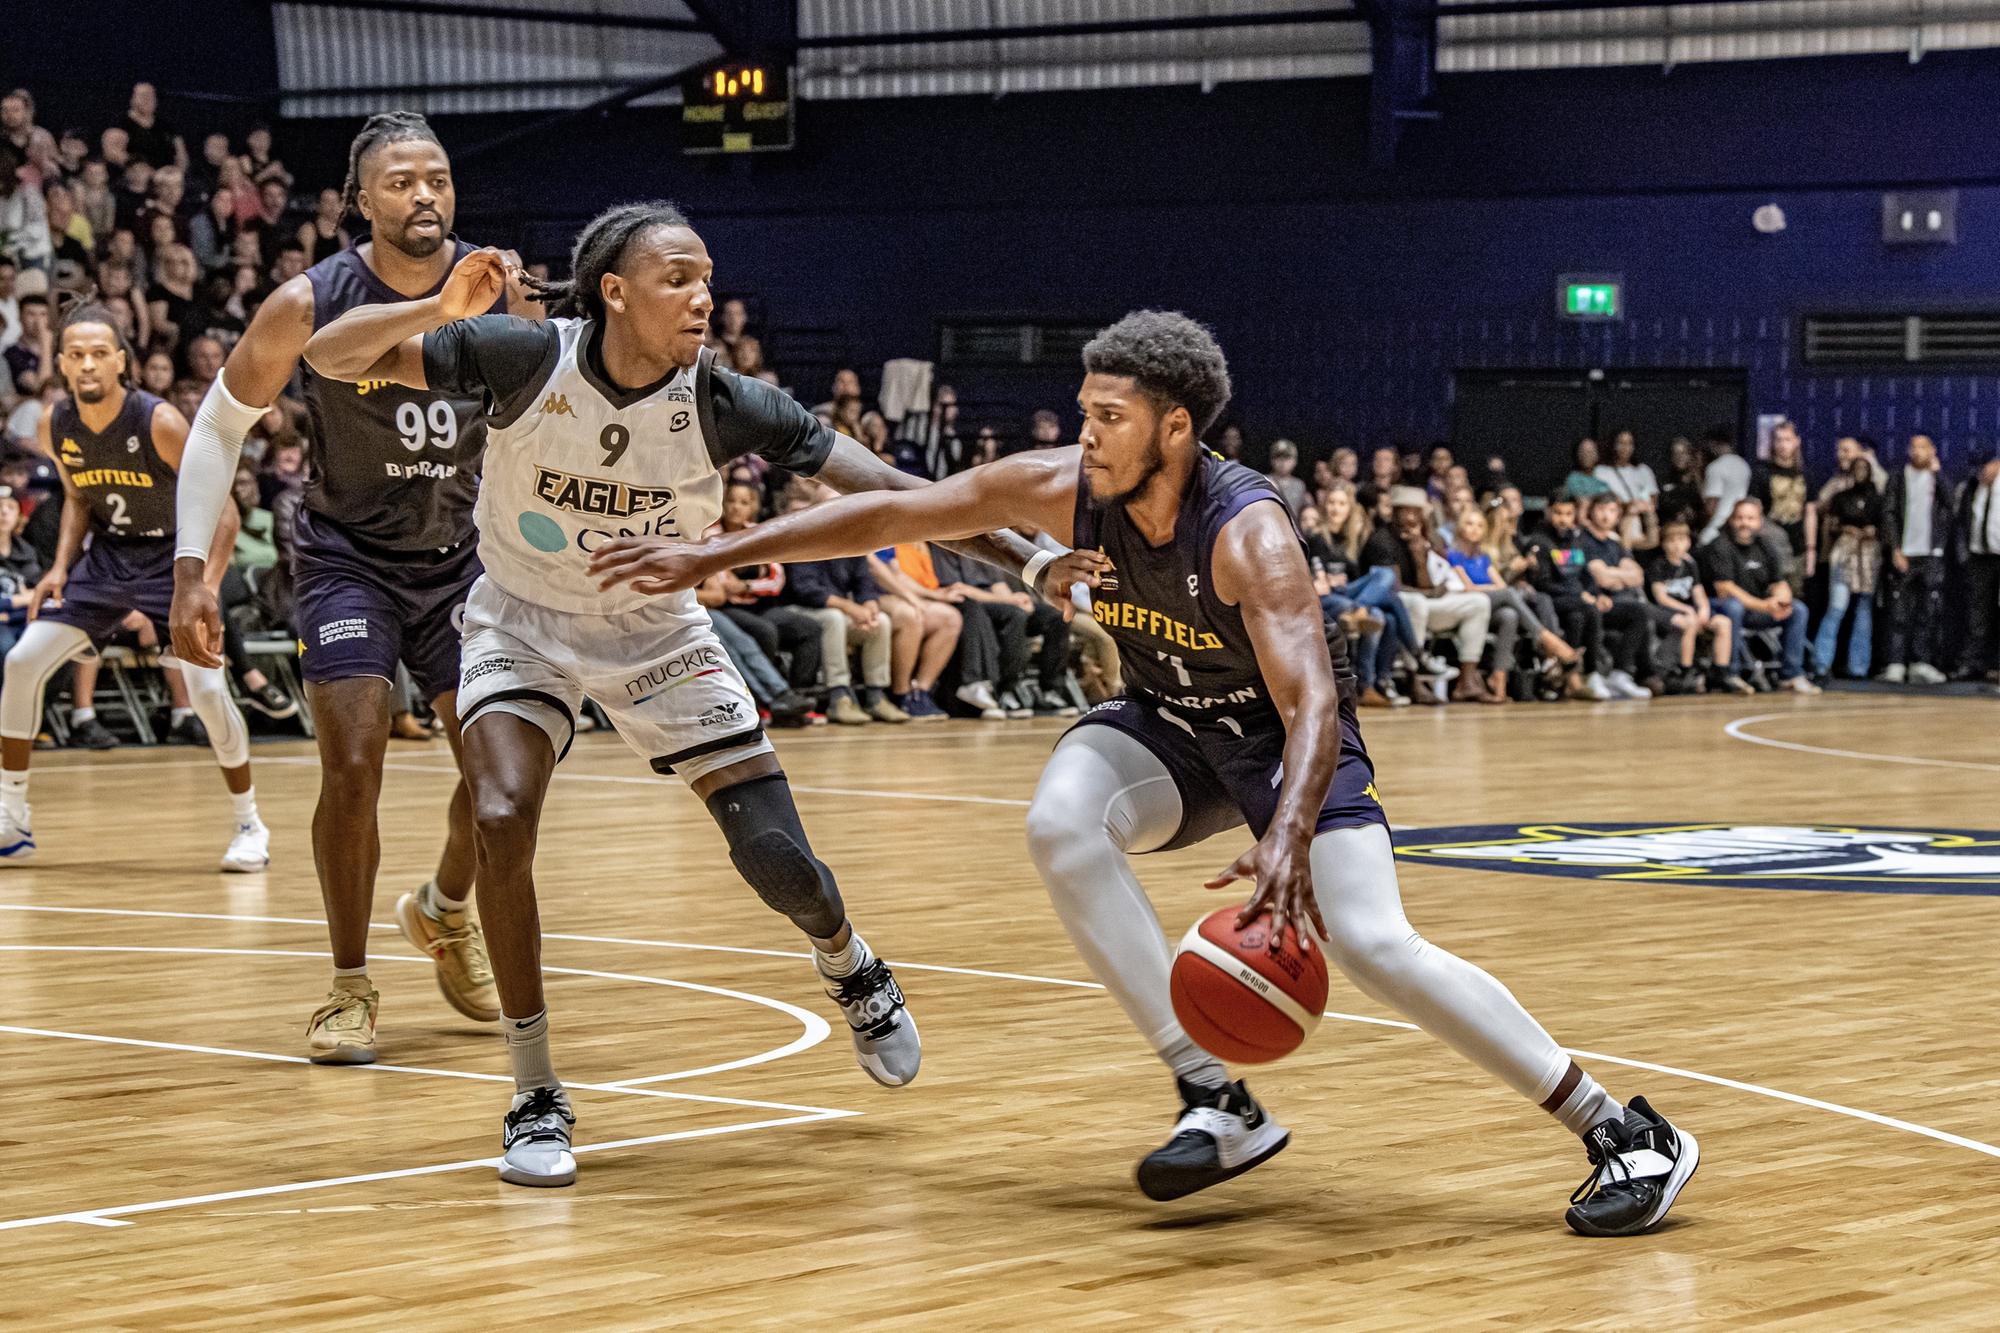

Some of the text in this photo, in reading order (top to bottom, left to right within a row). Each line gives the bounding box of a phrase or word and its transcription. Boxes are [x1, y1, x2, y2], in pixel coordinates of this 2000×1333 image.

[396, 400, 458, 451] 99
[600, 423, 630, 467] 9
[72, 469, 154, 488] SHEFFIELD
[536, 469, 673, 518] EAGLES
[106, 493, 132, 525] 2
[319, 618, 367, 633] BRITISH
[320, 631, 369, 646] LEAGUE
[1093, 600, 1224, 650] SHEFFIELD
[625, 648, 720, 697] muckle
[1240, 969, 1269, 993] BG4500
